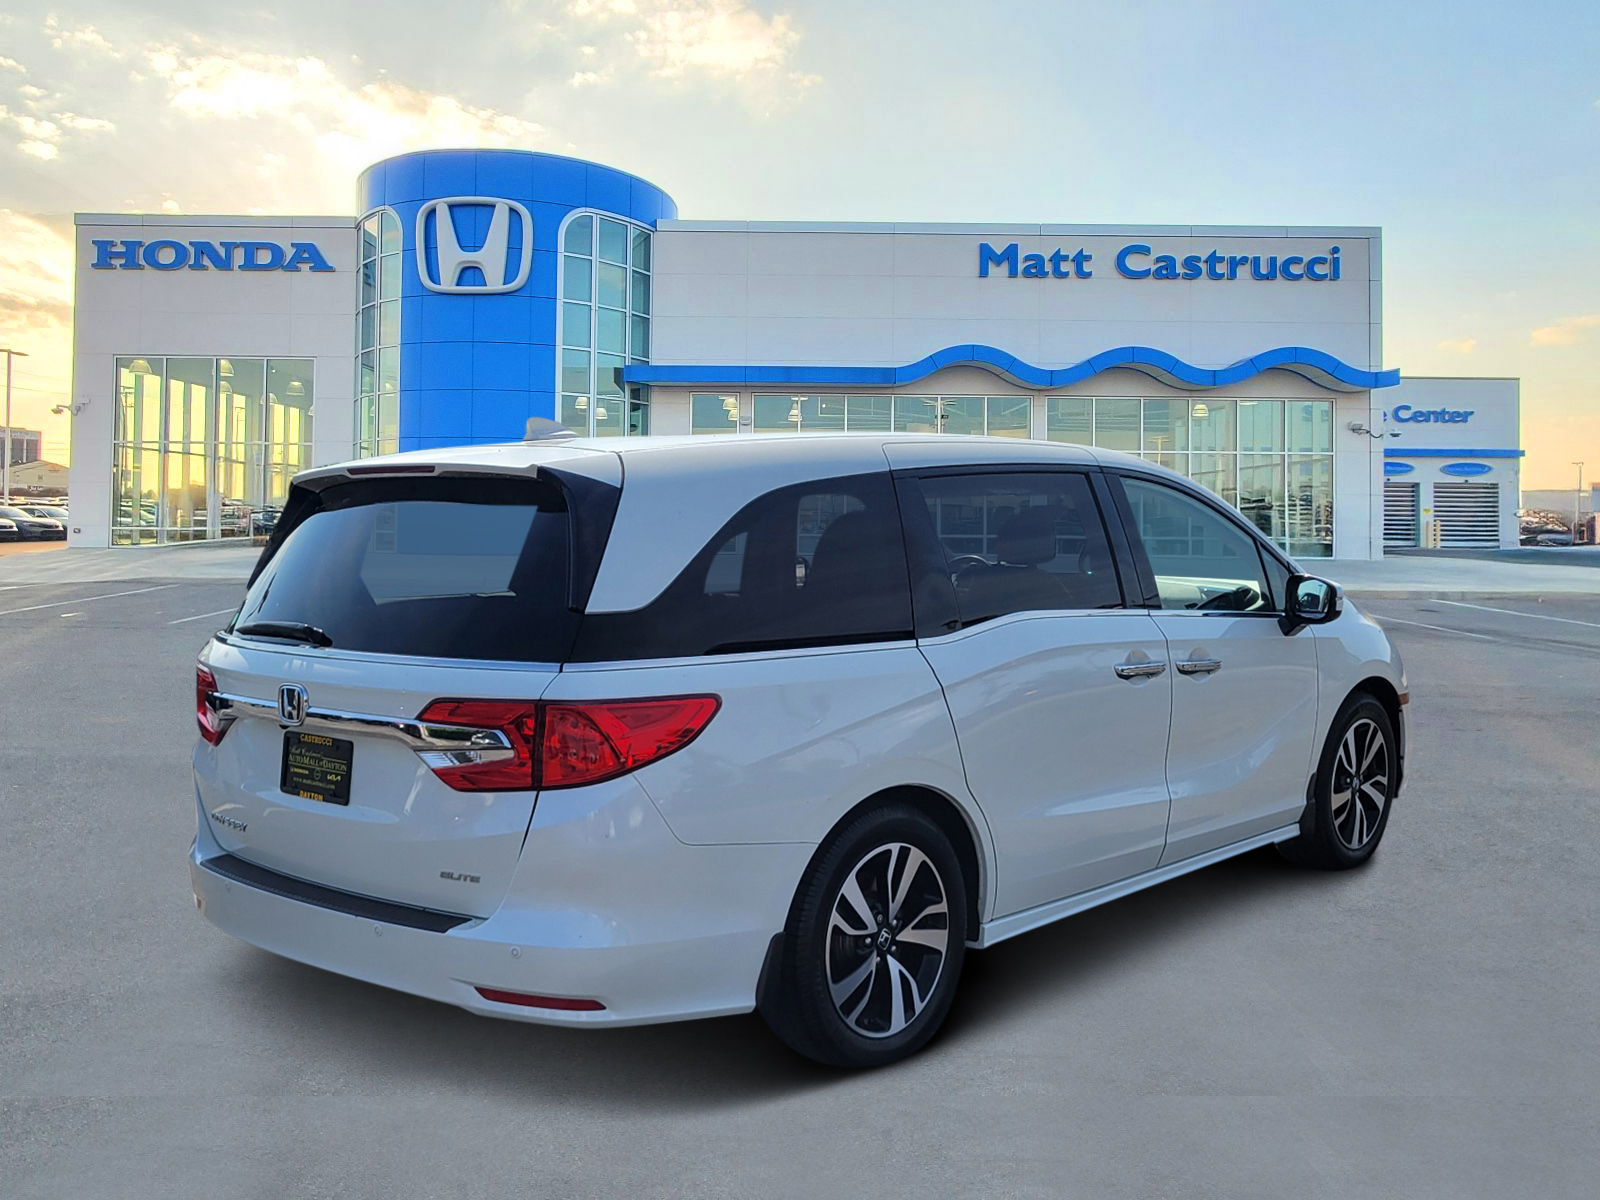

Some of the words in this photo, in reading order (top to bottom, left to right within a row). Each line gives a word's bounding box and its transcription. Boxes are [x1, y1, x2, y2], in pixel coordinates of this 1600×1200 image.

[91, 239, 336, 272] HONDA
[978, 242, 1093, 279] Matt
[1115, 243, 1342, 281] Castrucci
[1392, 404, 1475, 424] Center
[300, 733, 333, 746] CASTRUCCI
[299, 790, 324, 802] DAYTON
